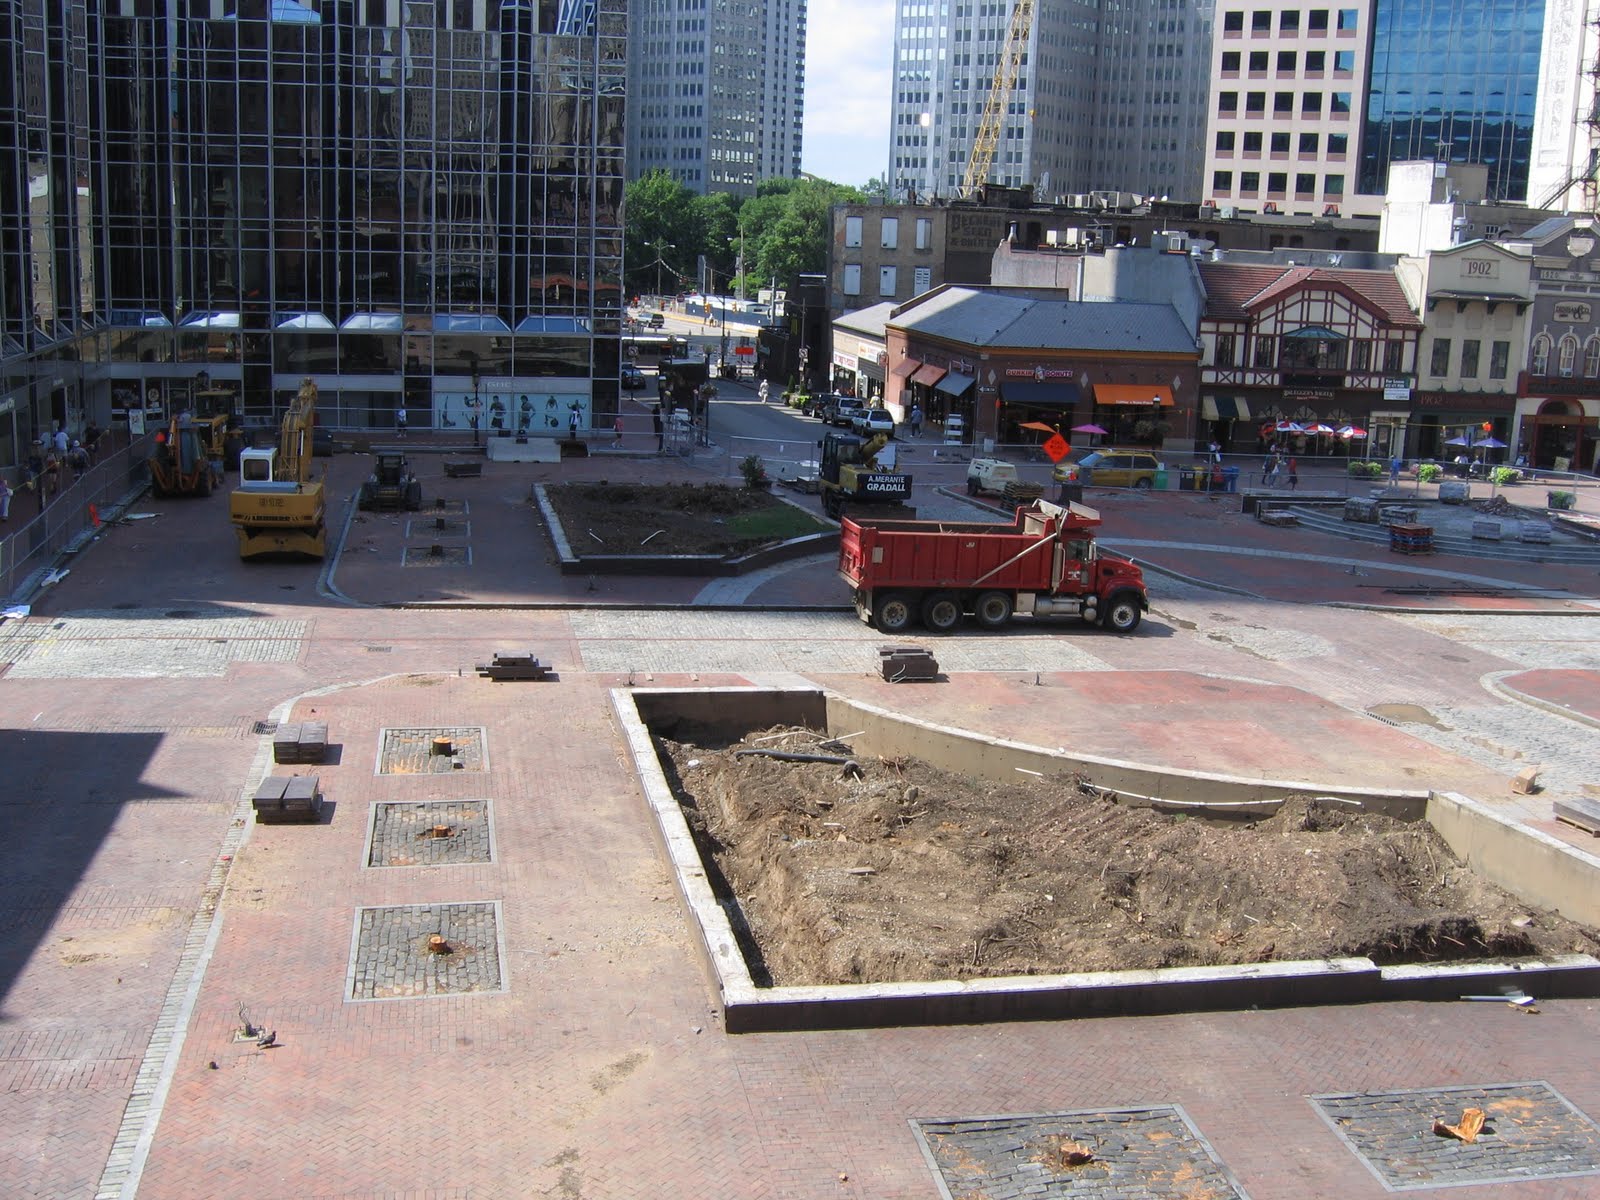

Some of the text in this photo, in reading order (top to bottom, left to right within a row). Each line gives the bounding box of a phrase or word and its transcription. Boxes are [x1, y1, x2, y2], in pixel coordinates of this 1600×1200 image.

[1468, 261, 1491, 275] 1902
[1044, 370, 1074, 378] DONUTS
[867, 483, 906, 492] GRADALL
